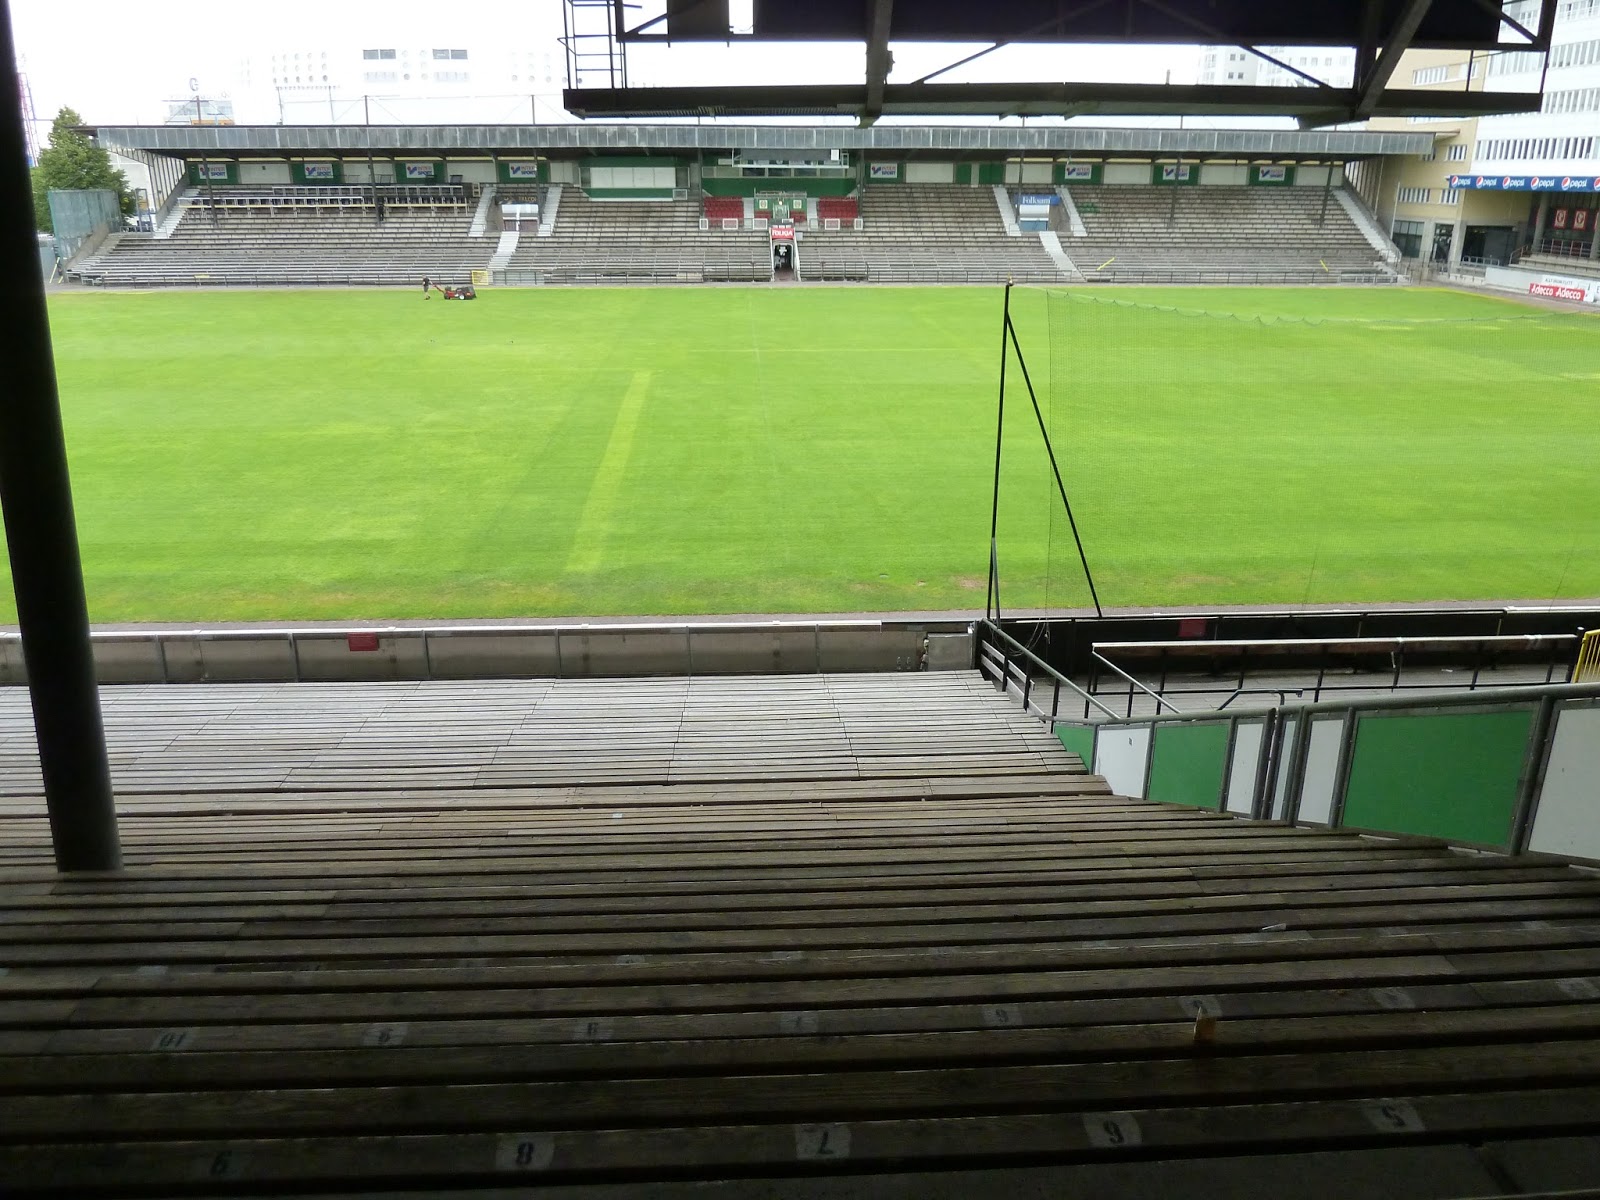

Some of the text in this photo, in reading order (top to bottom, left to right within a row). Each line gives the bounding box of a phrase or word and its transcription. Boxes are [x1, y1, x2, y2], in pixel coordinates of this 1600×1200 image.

[1457, 178, 1587, 188] pepsi pepsi pepsi pepsi pepsi
[1022, 195, 1051, 204] Folksam
[1531, 284, 1581, 300] Adecco Adecco
